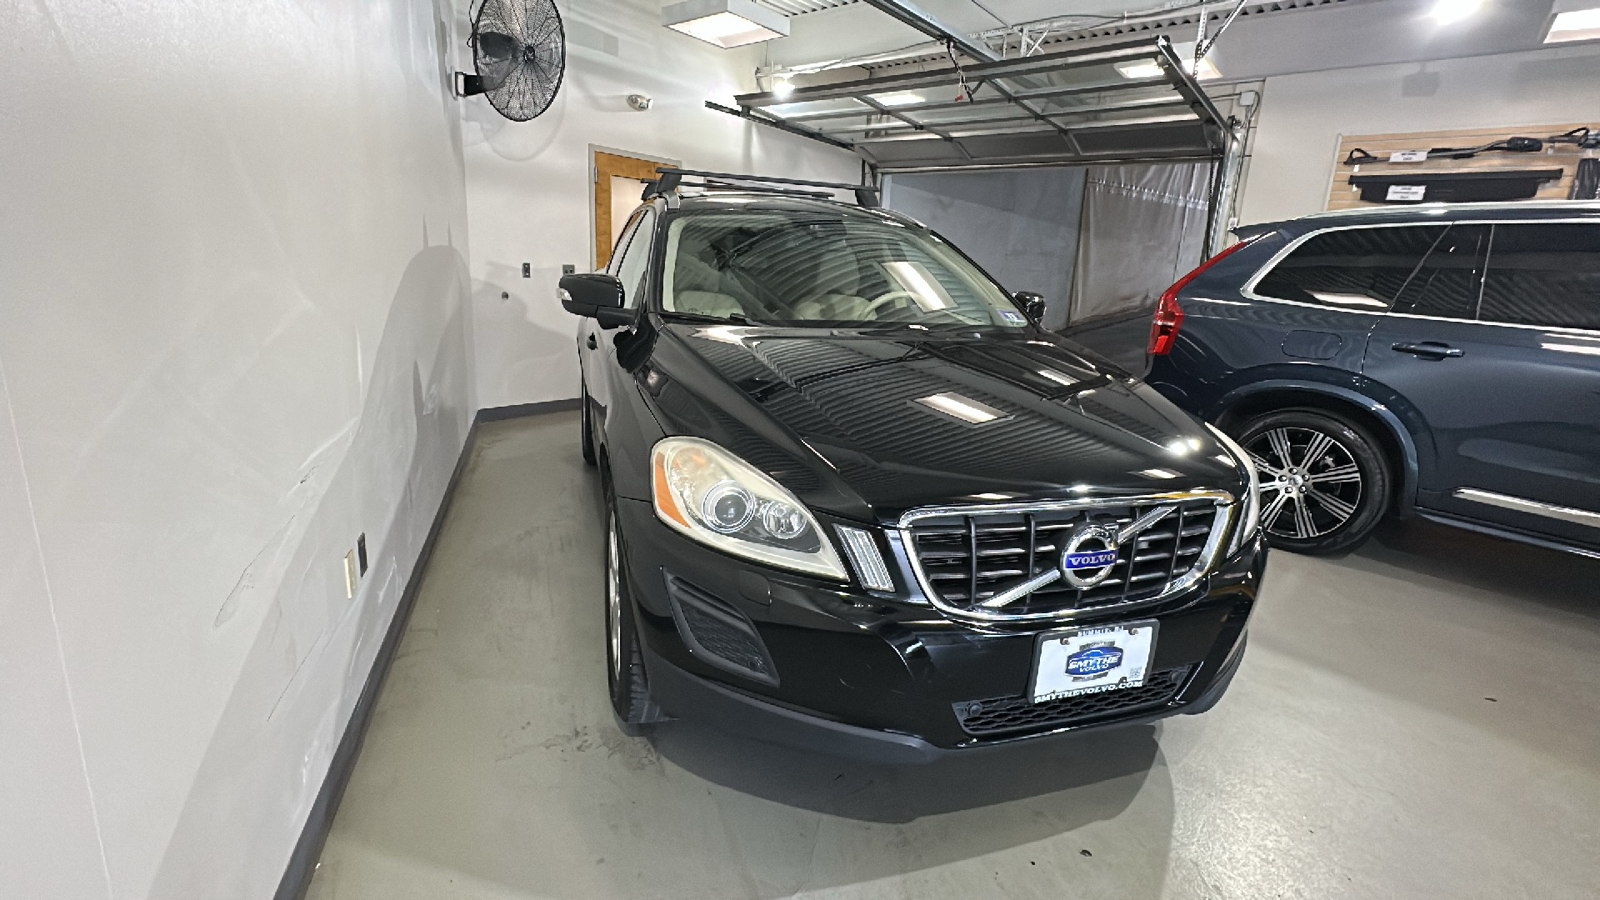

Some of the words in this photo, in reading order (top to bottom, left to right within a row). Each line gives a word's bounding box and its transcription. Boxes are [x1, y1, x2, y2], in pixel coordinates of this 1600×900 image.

[1069, 553, 1115, 566] VOLVO
[1068, 656, 1119, 670] SMYTHE
[1079, 664, 1109, 672] VOLVO
[1034, 681, 1143, 704] SMYTHEVOLVO.COM
